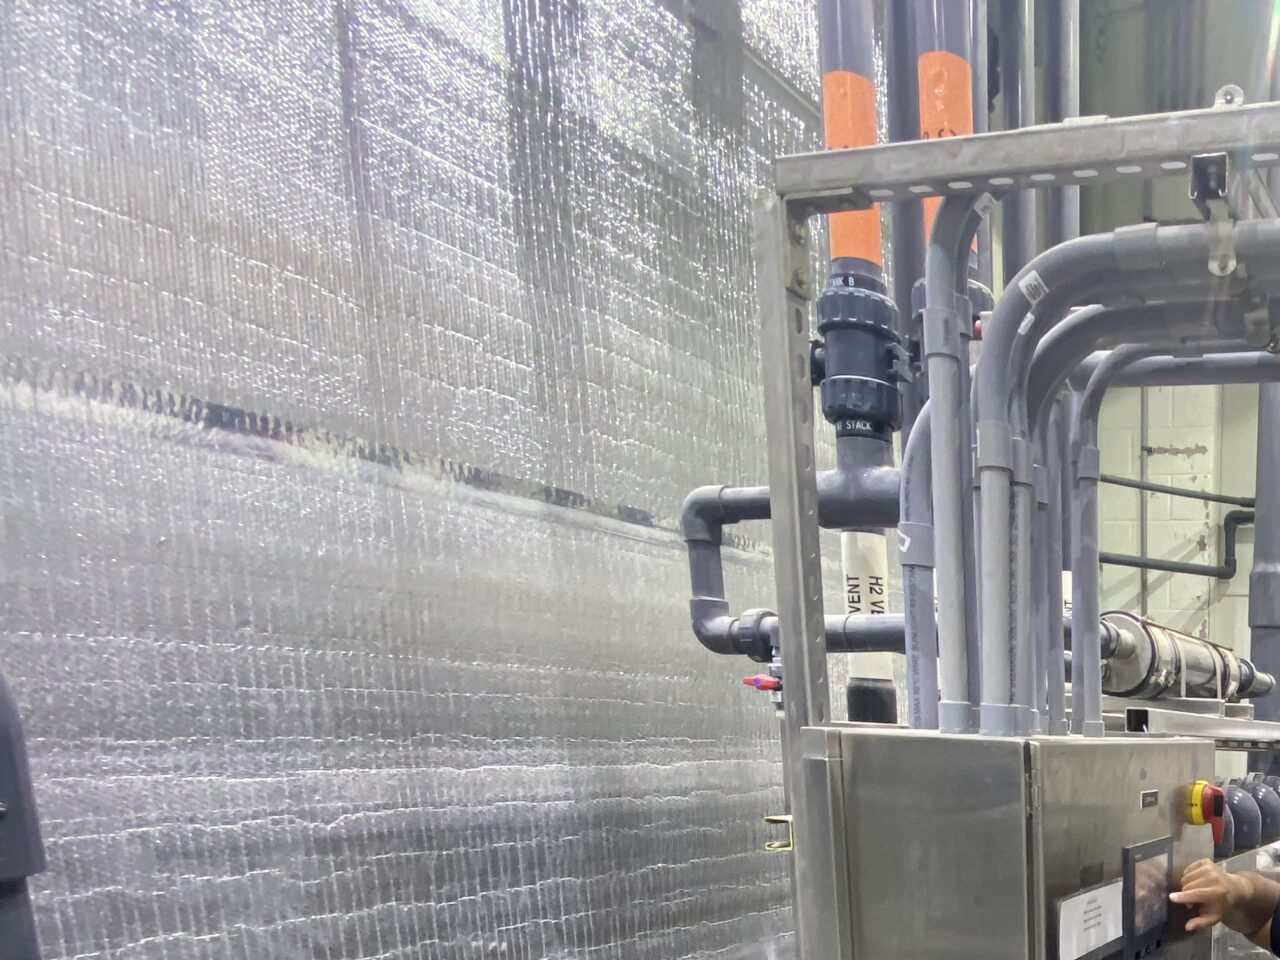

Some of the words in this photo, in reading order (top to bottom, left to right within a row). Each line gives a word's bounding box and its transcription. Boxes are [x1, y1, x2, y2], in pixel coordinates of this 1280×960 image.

[831, 276, 844, 286] ANK
[848, 276, 855, 286] B
[845, 419, 872, 431] STACK
[869, 575, 884, 595] H2
[846, 573, 861, 614] VENT
